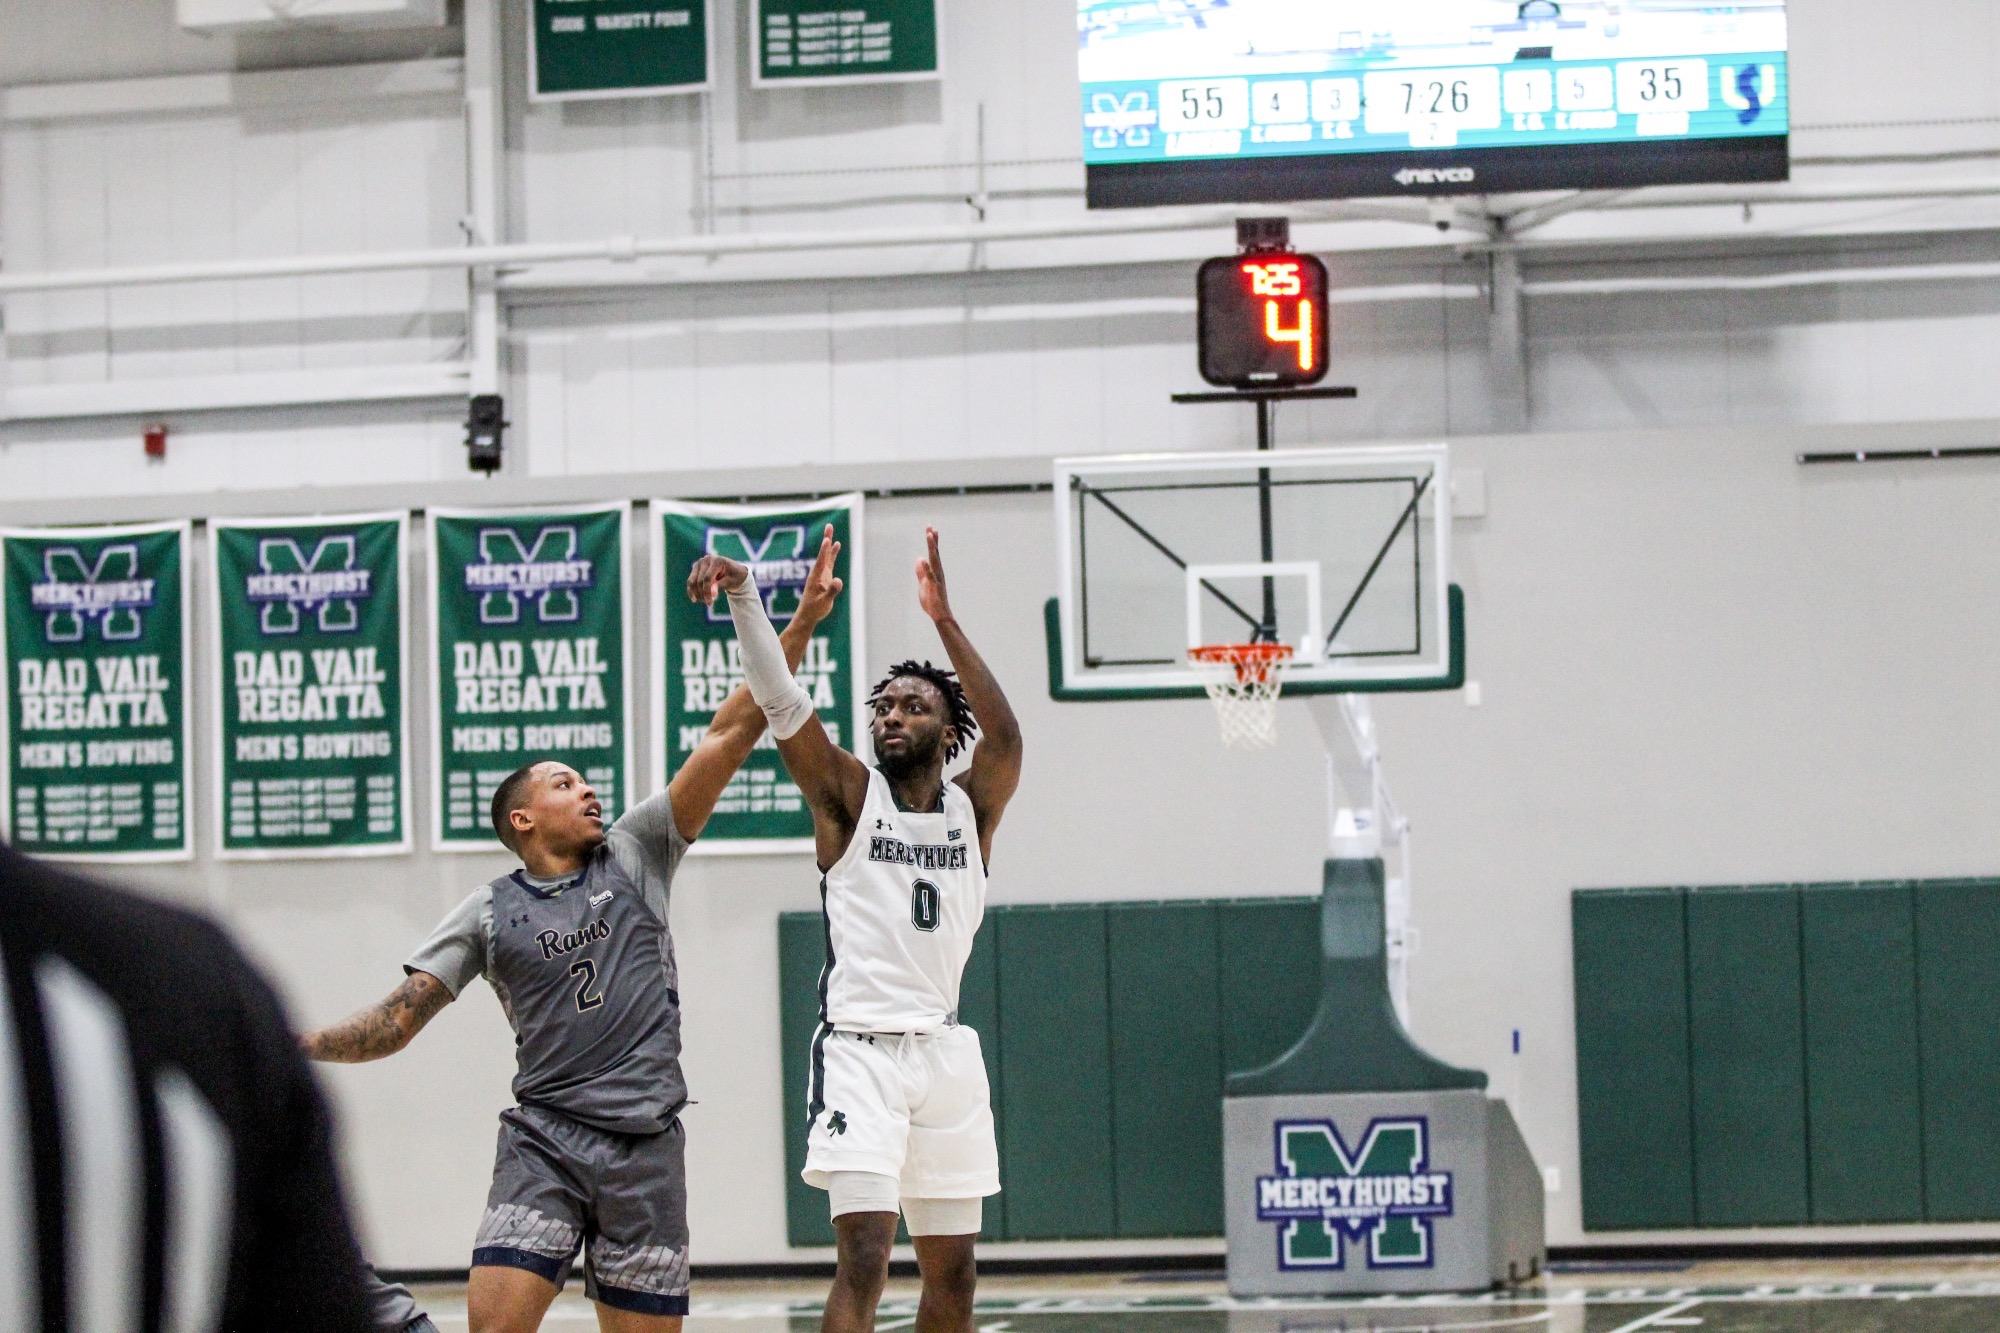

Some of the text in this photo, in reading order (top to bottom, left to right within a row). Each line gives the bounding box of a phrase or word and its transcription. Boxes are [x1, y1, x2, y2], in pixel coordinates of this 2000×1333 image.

[1182, 87, 1223, 119] 55
[1270, 92, 1280, 112] 4
[1400, 80, 1469, 115] 7:26
[1640, 67, 1682, 101] 35
[1265, 298, 1313, 372] 4
[18, 654, 169, 695] DAD VAIL
[234, 647, 386, 686] DAD VAIL
[454, 637, 608, 678] DAD VAIL
[21, 691, 168, 730] REGATTA
[237, 683, 385, 723] REGATTA
[456, 674, 607, 713] REGATTA
[87, 738, 174, 767] ROWING
[303, 731, 391, 760] ROWING
[523, 722, 613, 751] ROWING
[911, 878, 941, 933] 0
[535, 918, 612, 961] Rams
[569, 958, 605, 1014] 2
[1259, 1173, 1449, 1209] MERCYHURST
